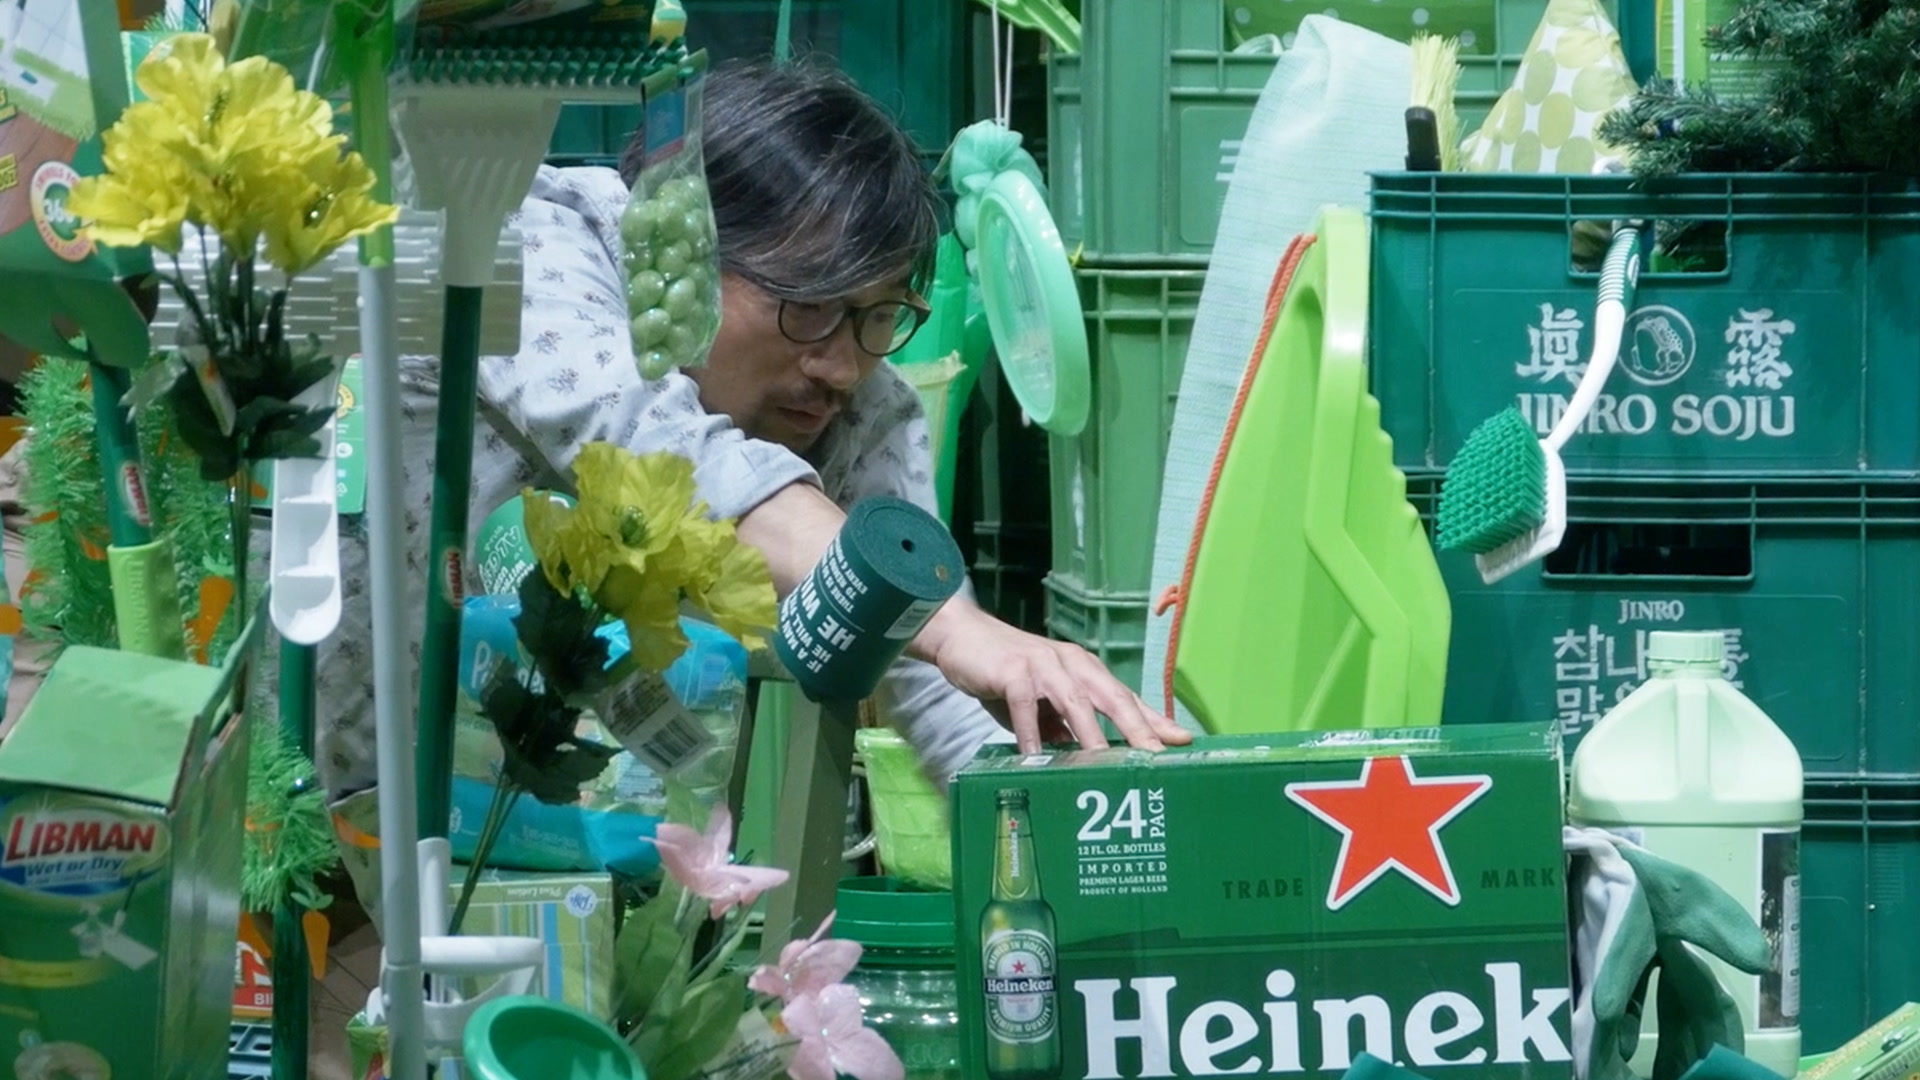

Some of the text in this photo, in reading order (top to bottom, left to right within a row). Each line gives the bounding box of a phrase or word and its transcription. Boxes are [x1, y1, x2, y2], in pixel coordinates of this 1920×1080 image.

[1671, 394, 1796, 441] SOJU
[800, 568, 822, 620] WIL
[844, 568, 869, 595] EVERY
[845, 586, 857, 600] TO
[830, 585, 855, 613] THERE
[1617, 599, 1685, 624] JINRO
[781, 620, 800, 651] MAN
[793, 612, 814, 649] WILL
[816, 614, 857, 653] HE
[797, 647, 809, 660] A
[812, 645, 833, 664] HE
[806, 659, 823, 674] IF
[1076, 787, 1166, 841] 24 PACK
[6, 816, 156, 861] LIBMAN
[1077, 846, 1090, 856] 12
[1123, 842, 1167, 854] BOTTLES
[27, 857, 123, 877] Wet or Dry
[1078, 861, 1168, 875] IMPORTED
[1079, 874, 1168, 886] PREMIUM LAGER BEER
[1079, 885, 1168, 896] PRODUCT OF HOLLAND
[1222, 867, 1556, 899] TRADE MARK
[987, 979, 1054, 993] Heineken
[1023, 1007, 1052, 1032] QUALITY
